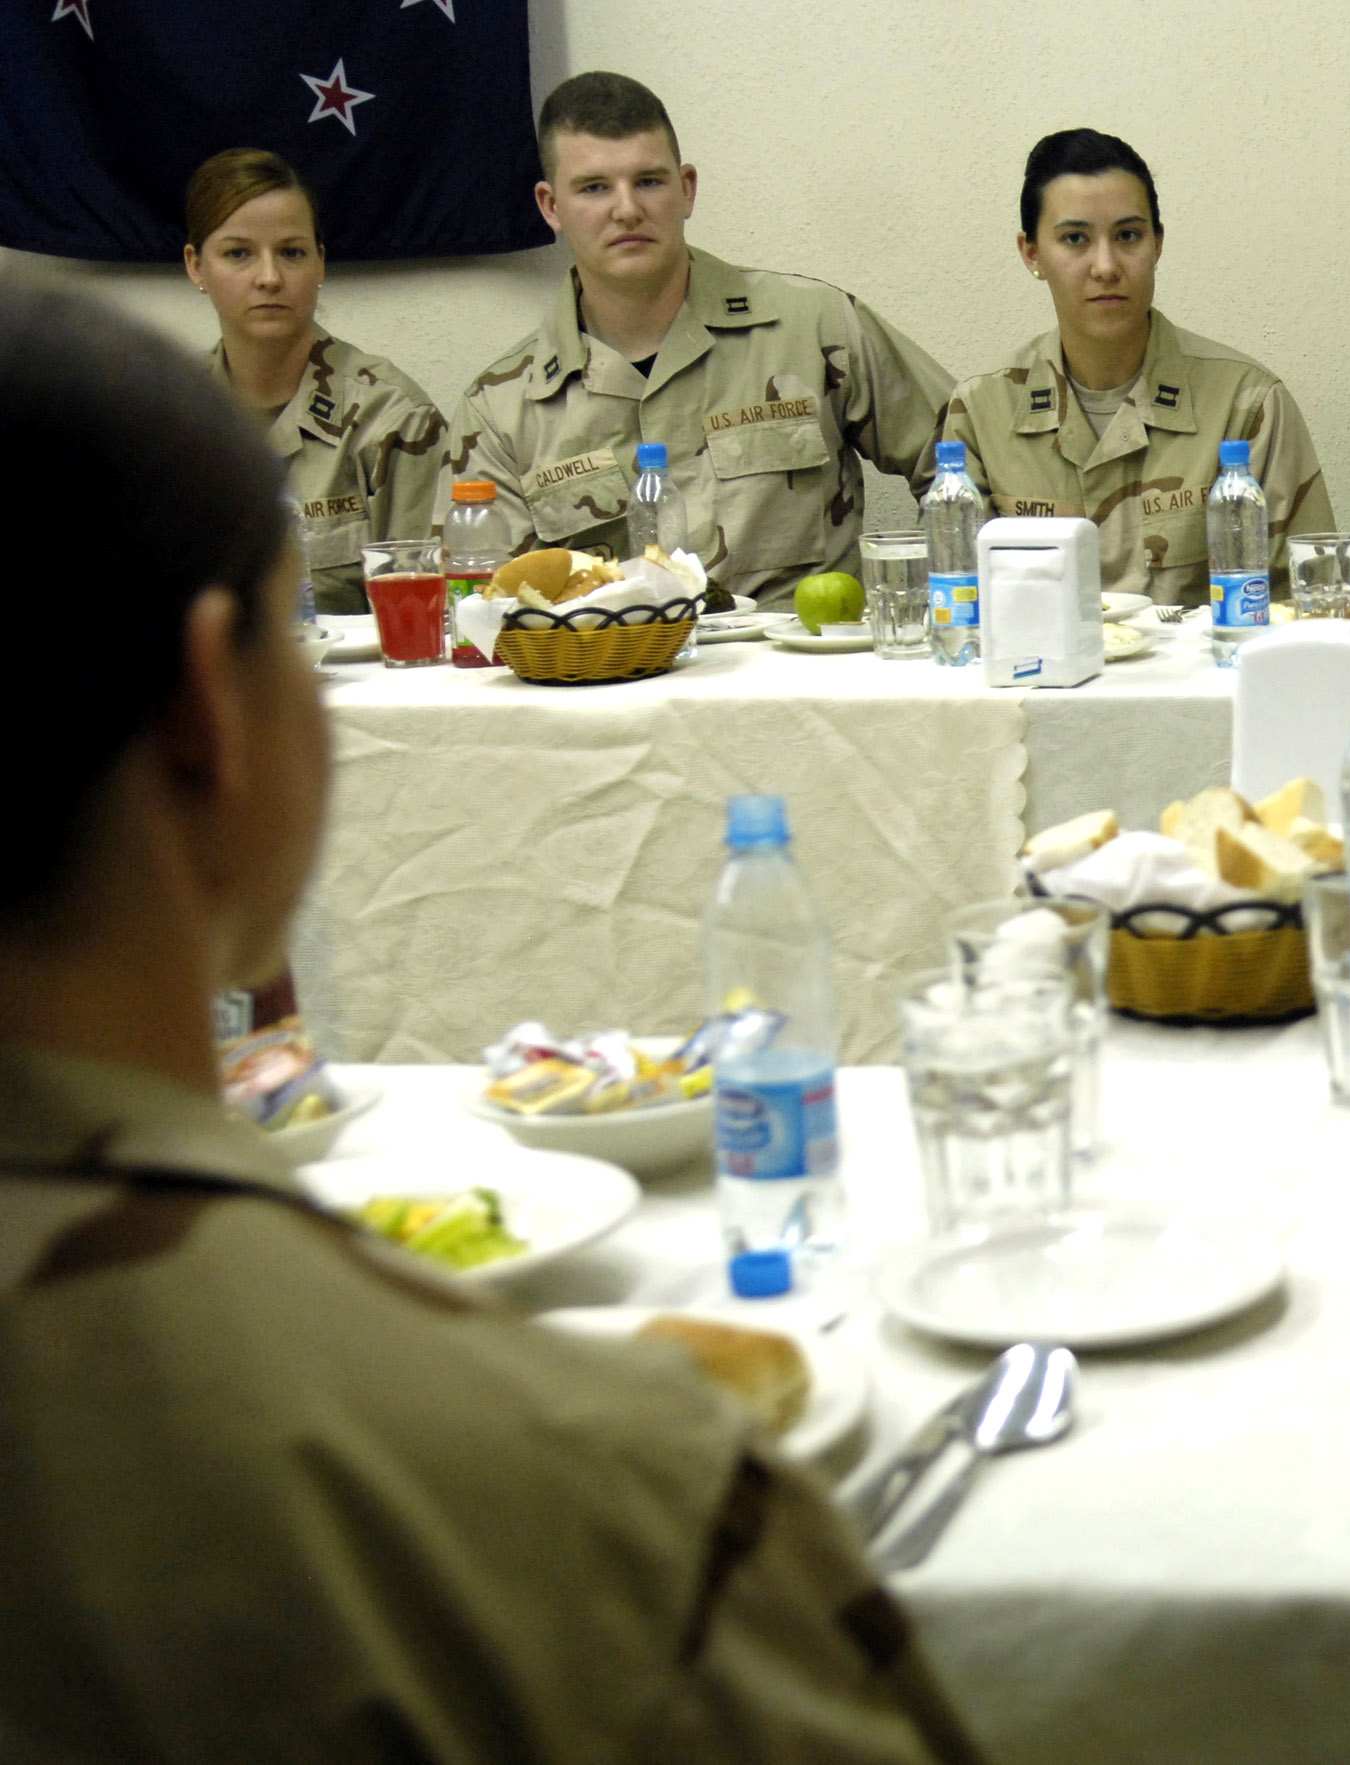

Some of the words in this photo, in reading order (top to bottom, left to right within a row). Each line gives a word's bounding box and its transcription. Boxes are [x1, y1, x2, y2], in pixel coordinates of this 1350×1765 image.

[709, 412, 735, 431] U.S.
[740, 405, 765, 425] AIR
[769, 399, 813, 419] FORCE
[535, 456, 600, 489] CALDWELL
[304, 501, 325, 519] AIR
[1015, 500, 1055, 518] SMITH
[1143, 496, 1165, 515] U.S.
[1169, 489, 1194, 510] AIR
